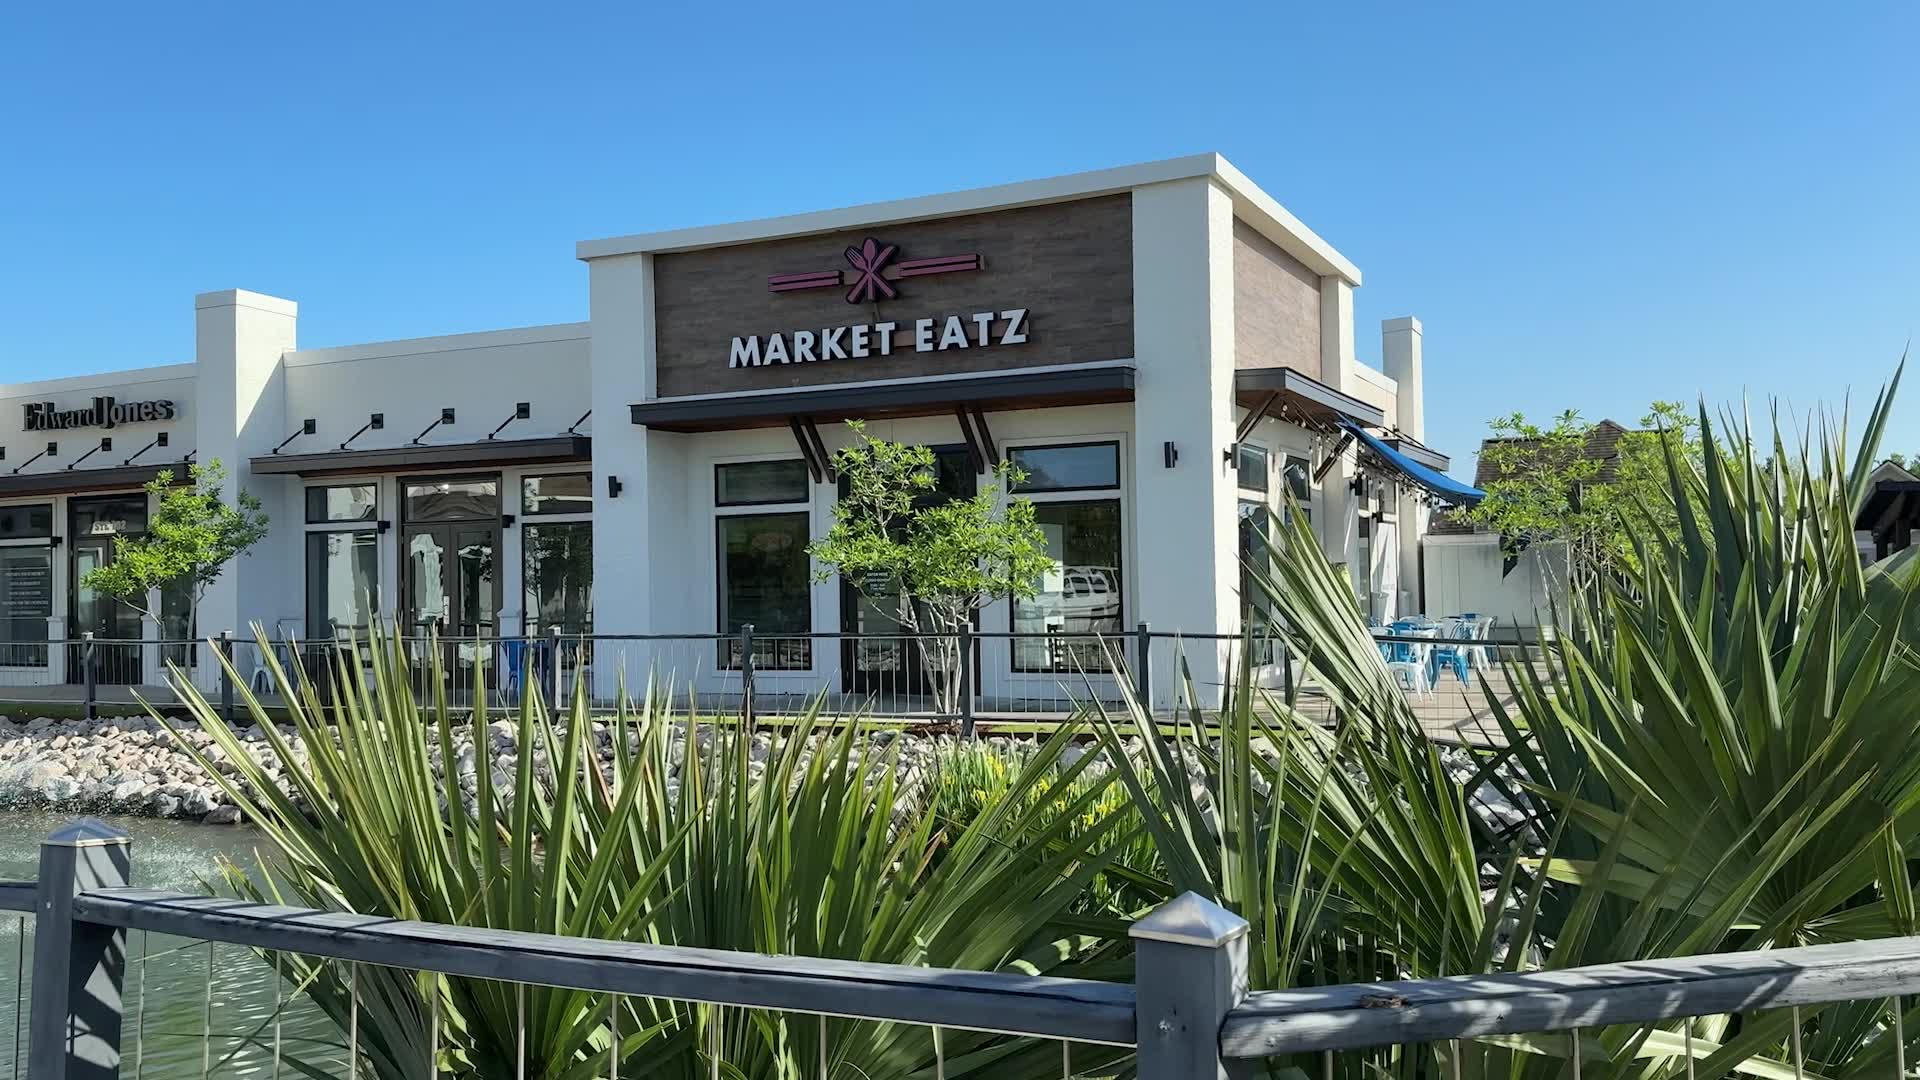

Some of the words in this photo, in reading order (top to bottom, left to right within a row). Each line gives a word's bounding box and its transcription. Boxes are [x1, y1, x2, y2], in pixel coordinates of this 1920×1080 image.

[728, 321, 896, 368] MARKET
[914, 308, 1029, 353] EATZ
[22, 397, 100, 431] Edward
[99, 396, 175, 429] Jones
